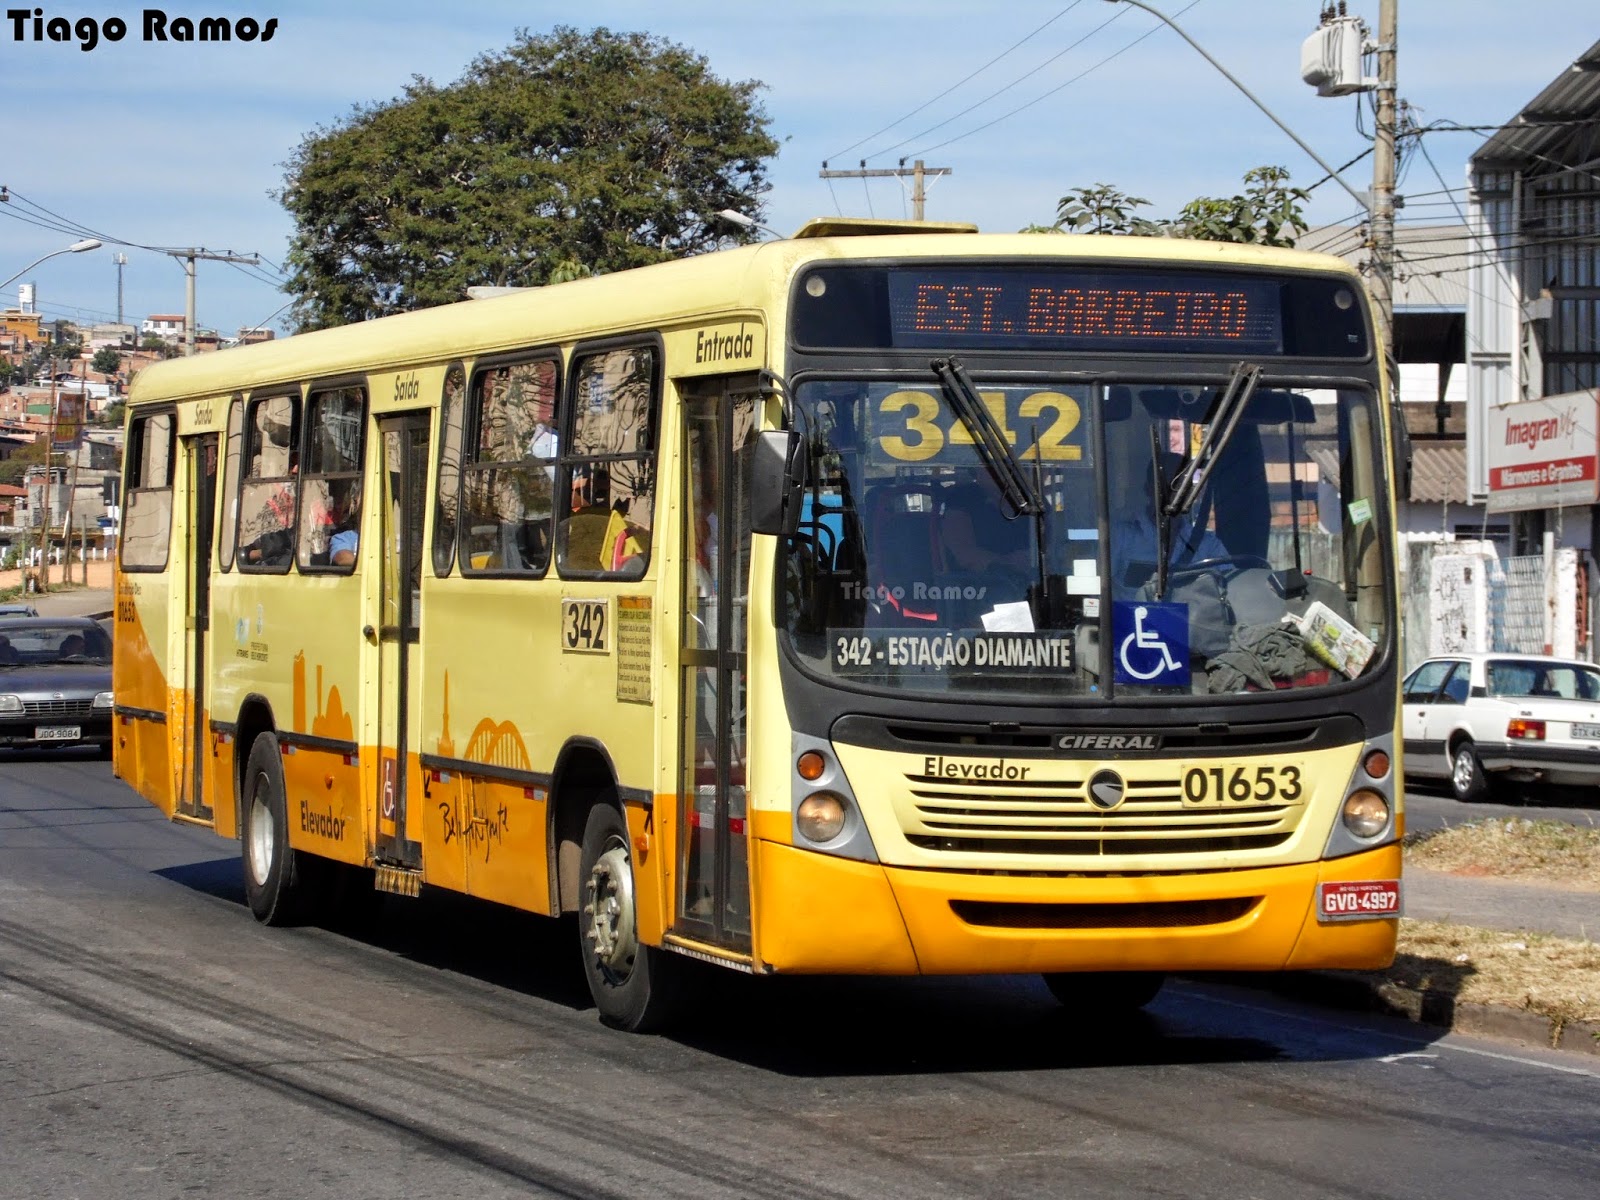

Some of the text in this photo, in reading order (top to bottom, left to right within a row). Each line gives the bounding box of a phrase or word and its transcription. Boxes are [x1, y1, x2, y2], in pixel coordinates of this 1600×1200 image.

[915, 284, 1248, 338] EST. BARREIRO
[696, 322, 753, 363] Entrada
[394, 371, 419, 401] Saída
[879, 391, 1081, 461] 342
[1506, 418, 1558, 450] Imagran
[567, 603, 604, 649] 342
[837, 637, 871, 666] 342
[888, 632, 970, 671] ESTAÇÃO
[974, 638, 1071, 667] DIAMANTE
[1058, 735, 1156, 750] CIFERAL
[924, 757, 1030, 780] Elevador
[1184, 766, 1301, 804] 01653
[300, 800, 345, 842] Elevador
